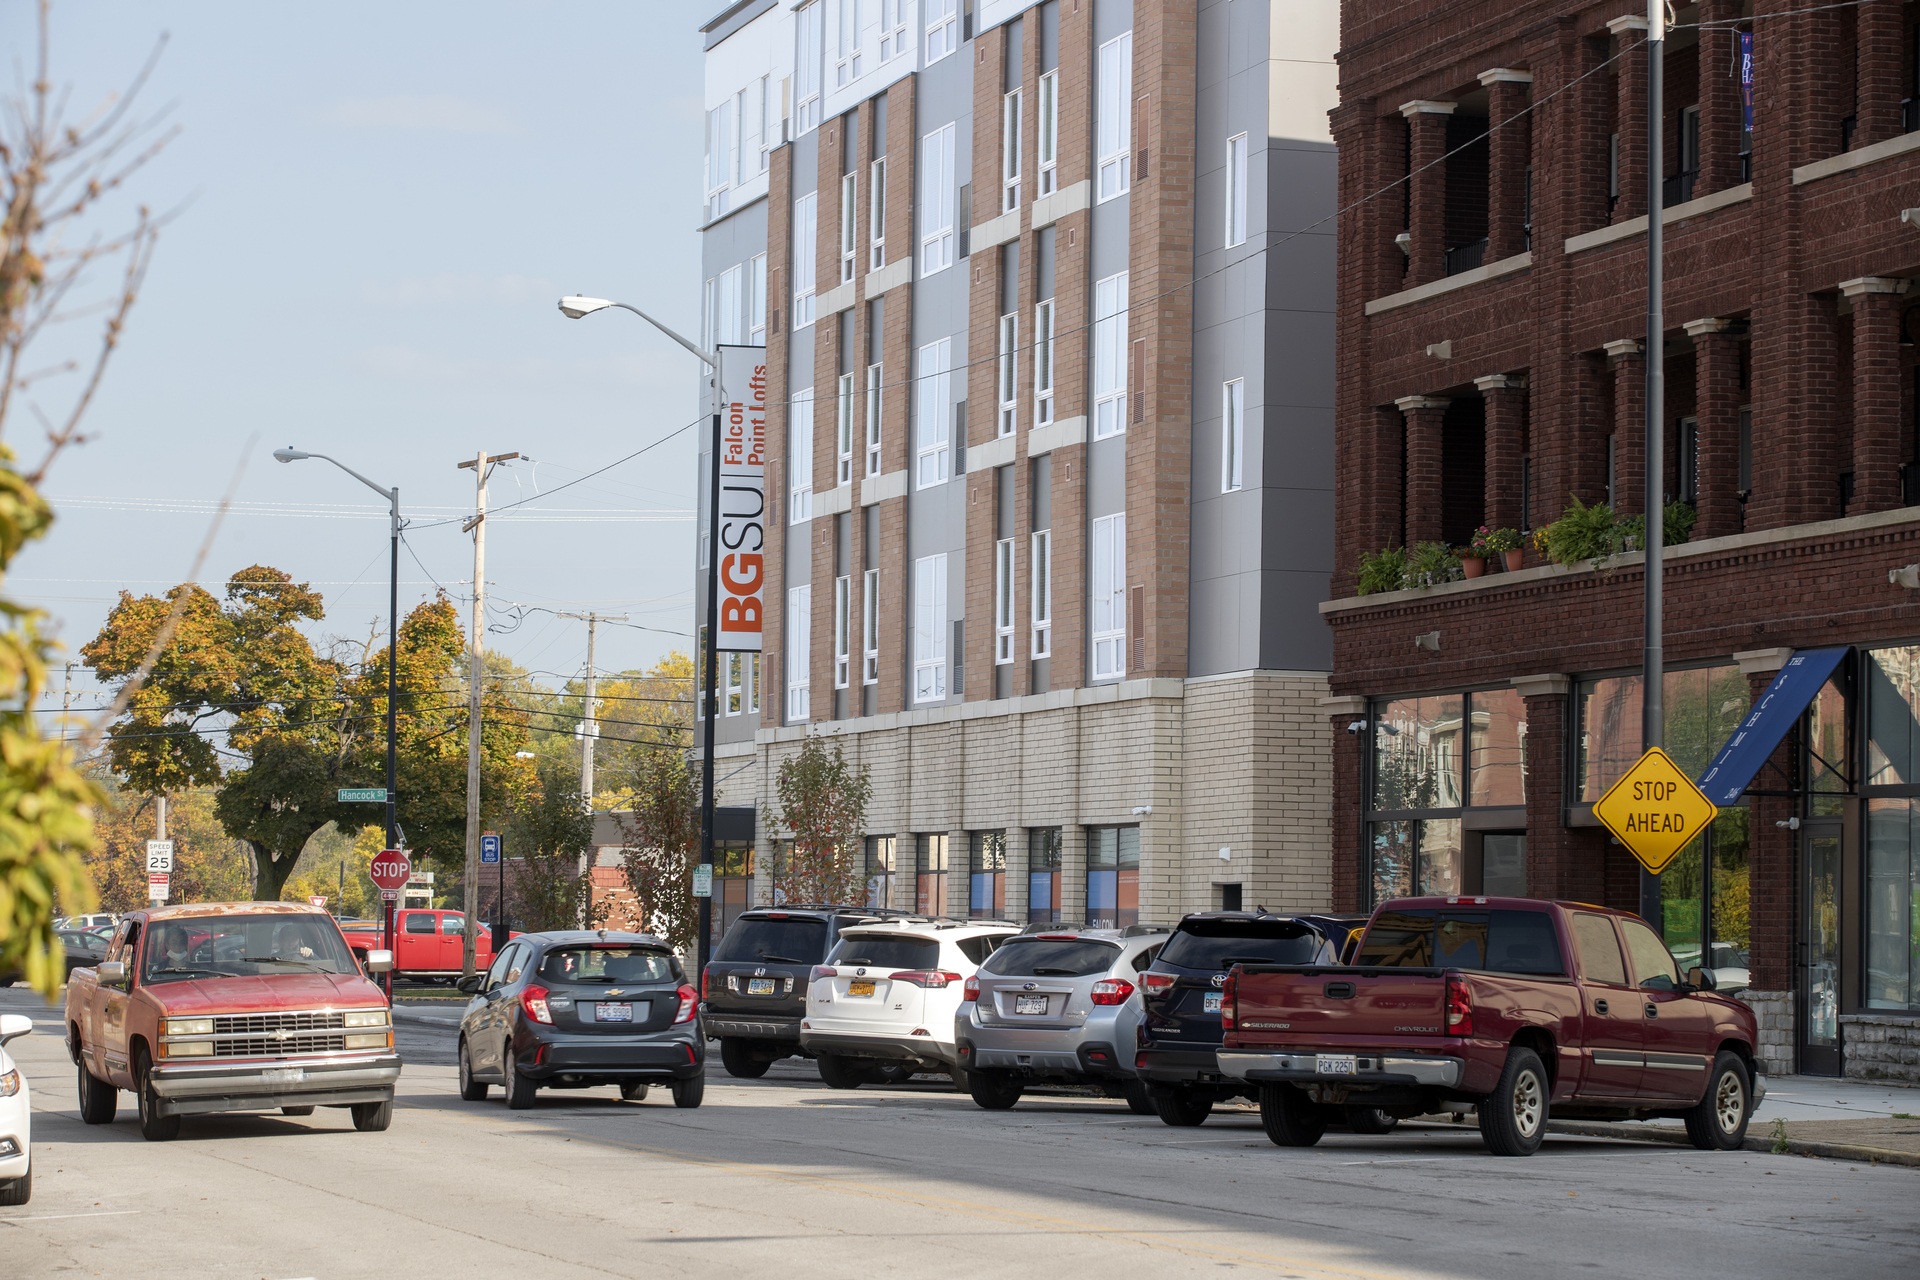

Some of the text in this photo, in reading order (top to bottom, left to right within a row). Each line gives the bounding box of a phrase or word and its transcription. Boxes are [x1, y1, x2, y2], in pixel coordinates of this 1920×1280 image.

[747, 365, 767, 466] Point Lofts
[724, 402, 744, 465] Falcon
[721, 486, 764, 633] BGSU
[1788, 656, 1806, 666] THE
[341, 790, 376, 800] Hancock
[1633, 781, 1677, 801] STOP
[1625, 812, 1685, 833] AHEAD
[150, 857, 169, 869] 25
[373, 862, 408, 877] STOP
[1030, 1000, 1045, 1010] 7291
[1318, 1060, 1353, 1074] PGK 2250
